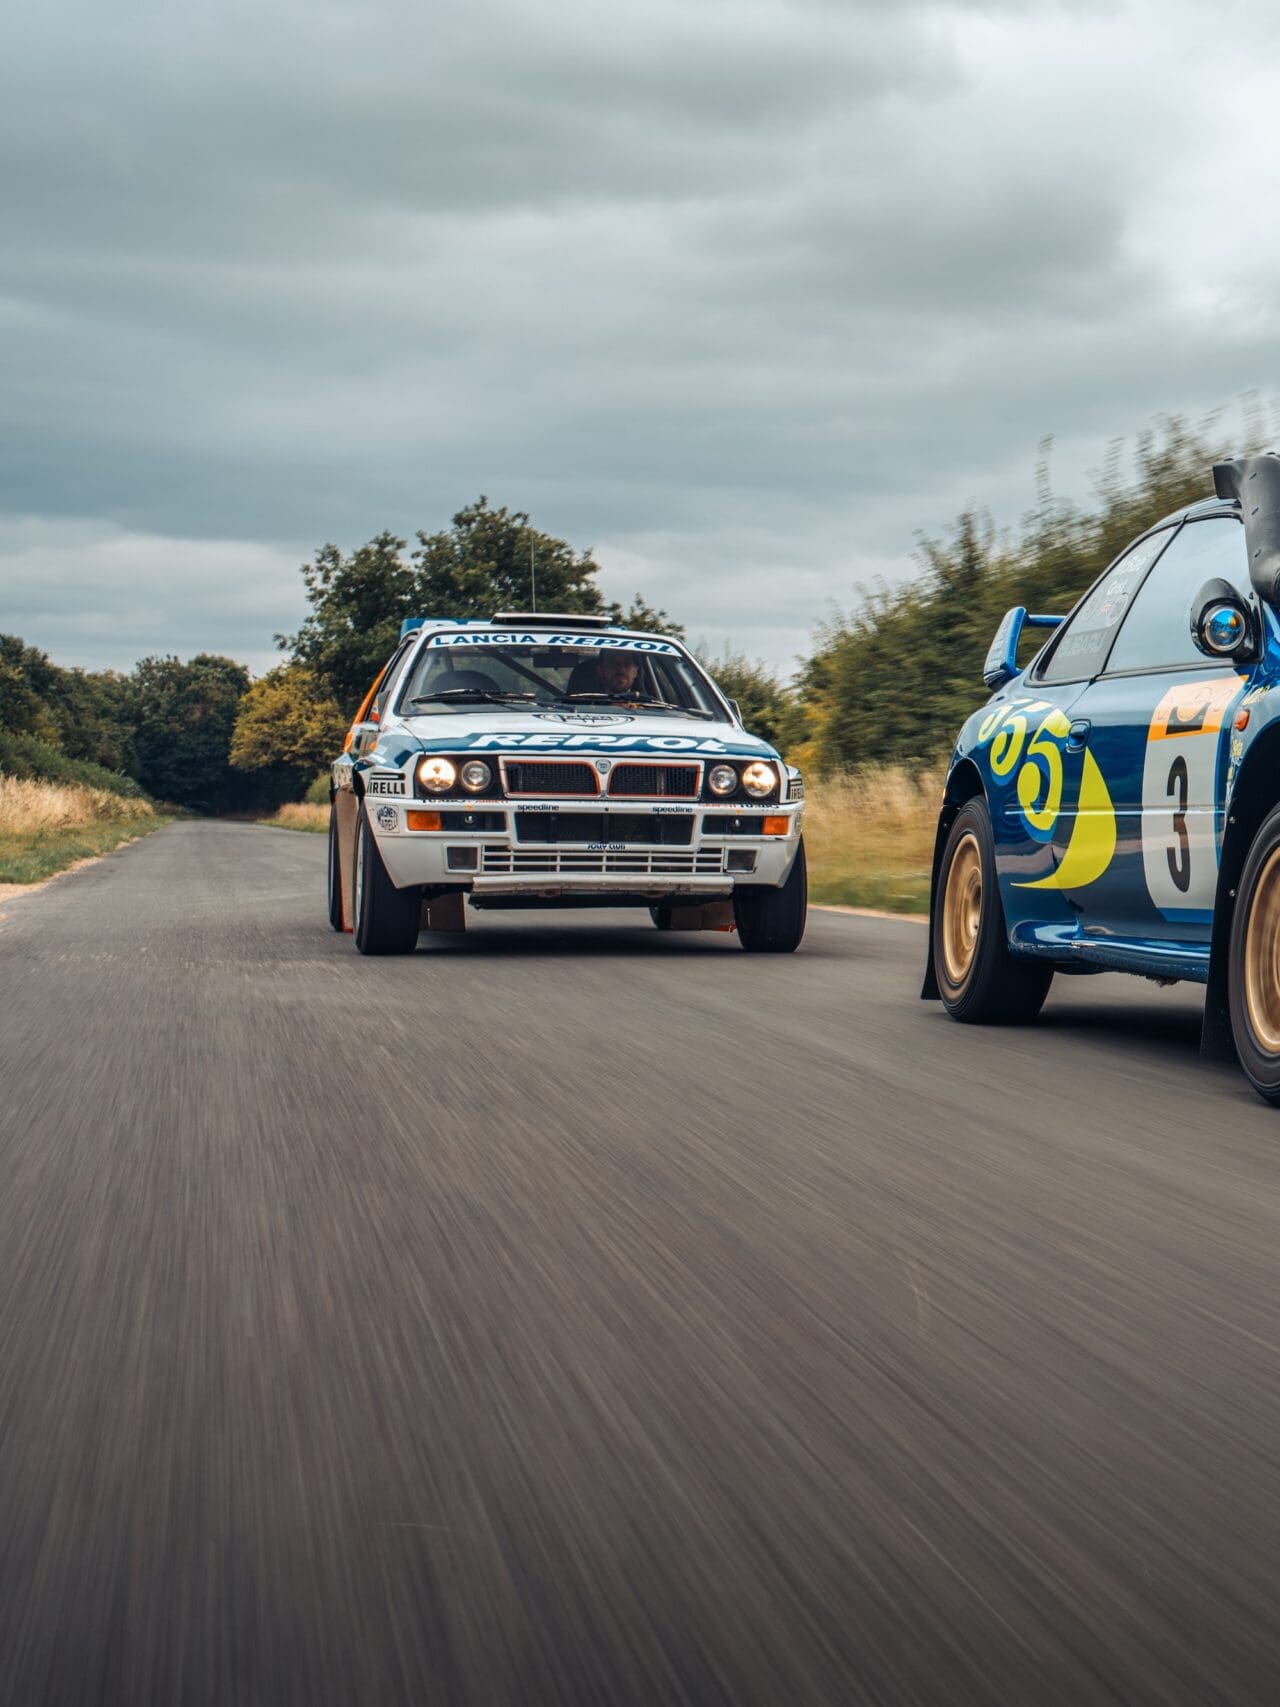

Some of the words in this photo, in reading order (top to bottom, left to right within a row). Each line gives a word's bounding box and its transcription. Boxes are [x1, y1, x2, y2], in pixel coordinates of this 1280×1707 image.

[435, 634, 536, 646] LANCIA
[547, 636, 673, 654] REPSOL
[469, 734, 727, 752] REPSOL
[517, 804, 560, 812] speedline
[652, 805, 693, 814] speedline
[1166, 755, 1191, 893] 3
